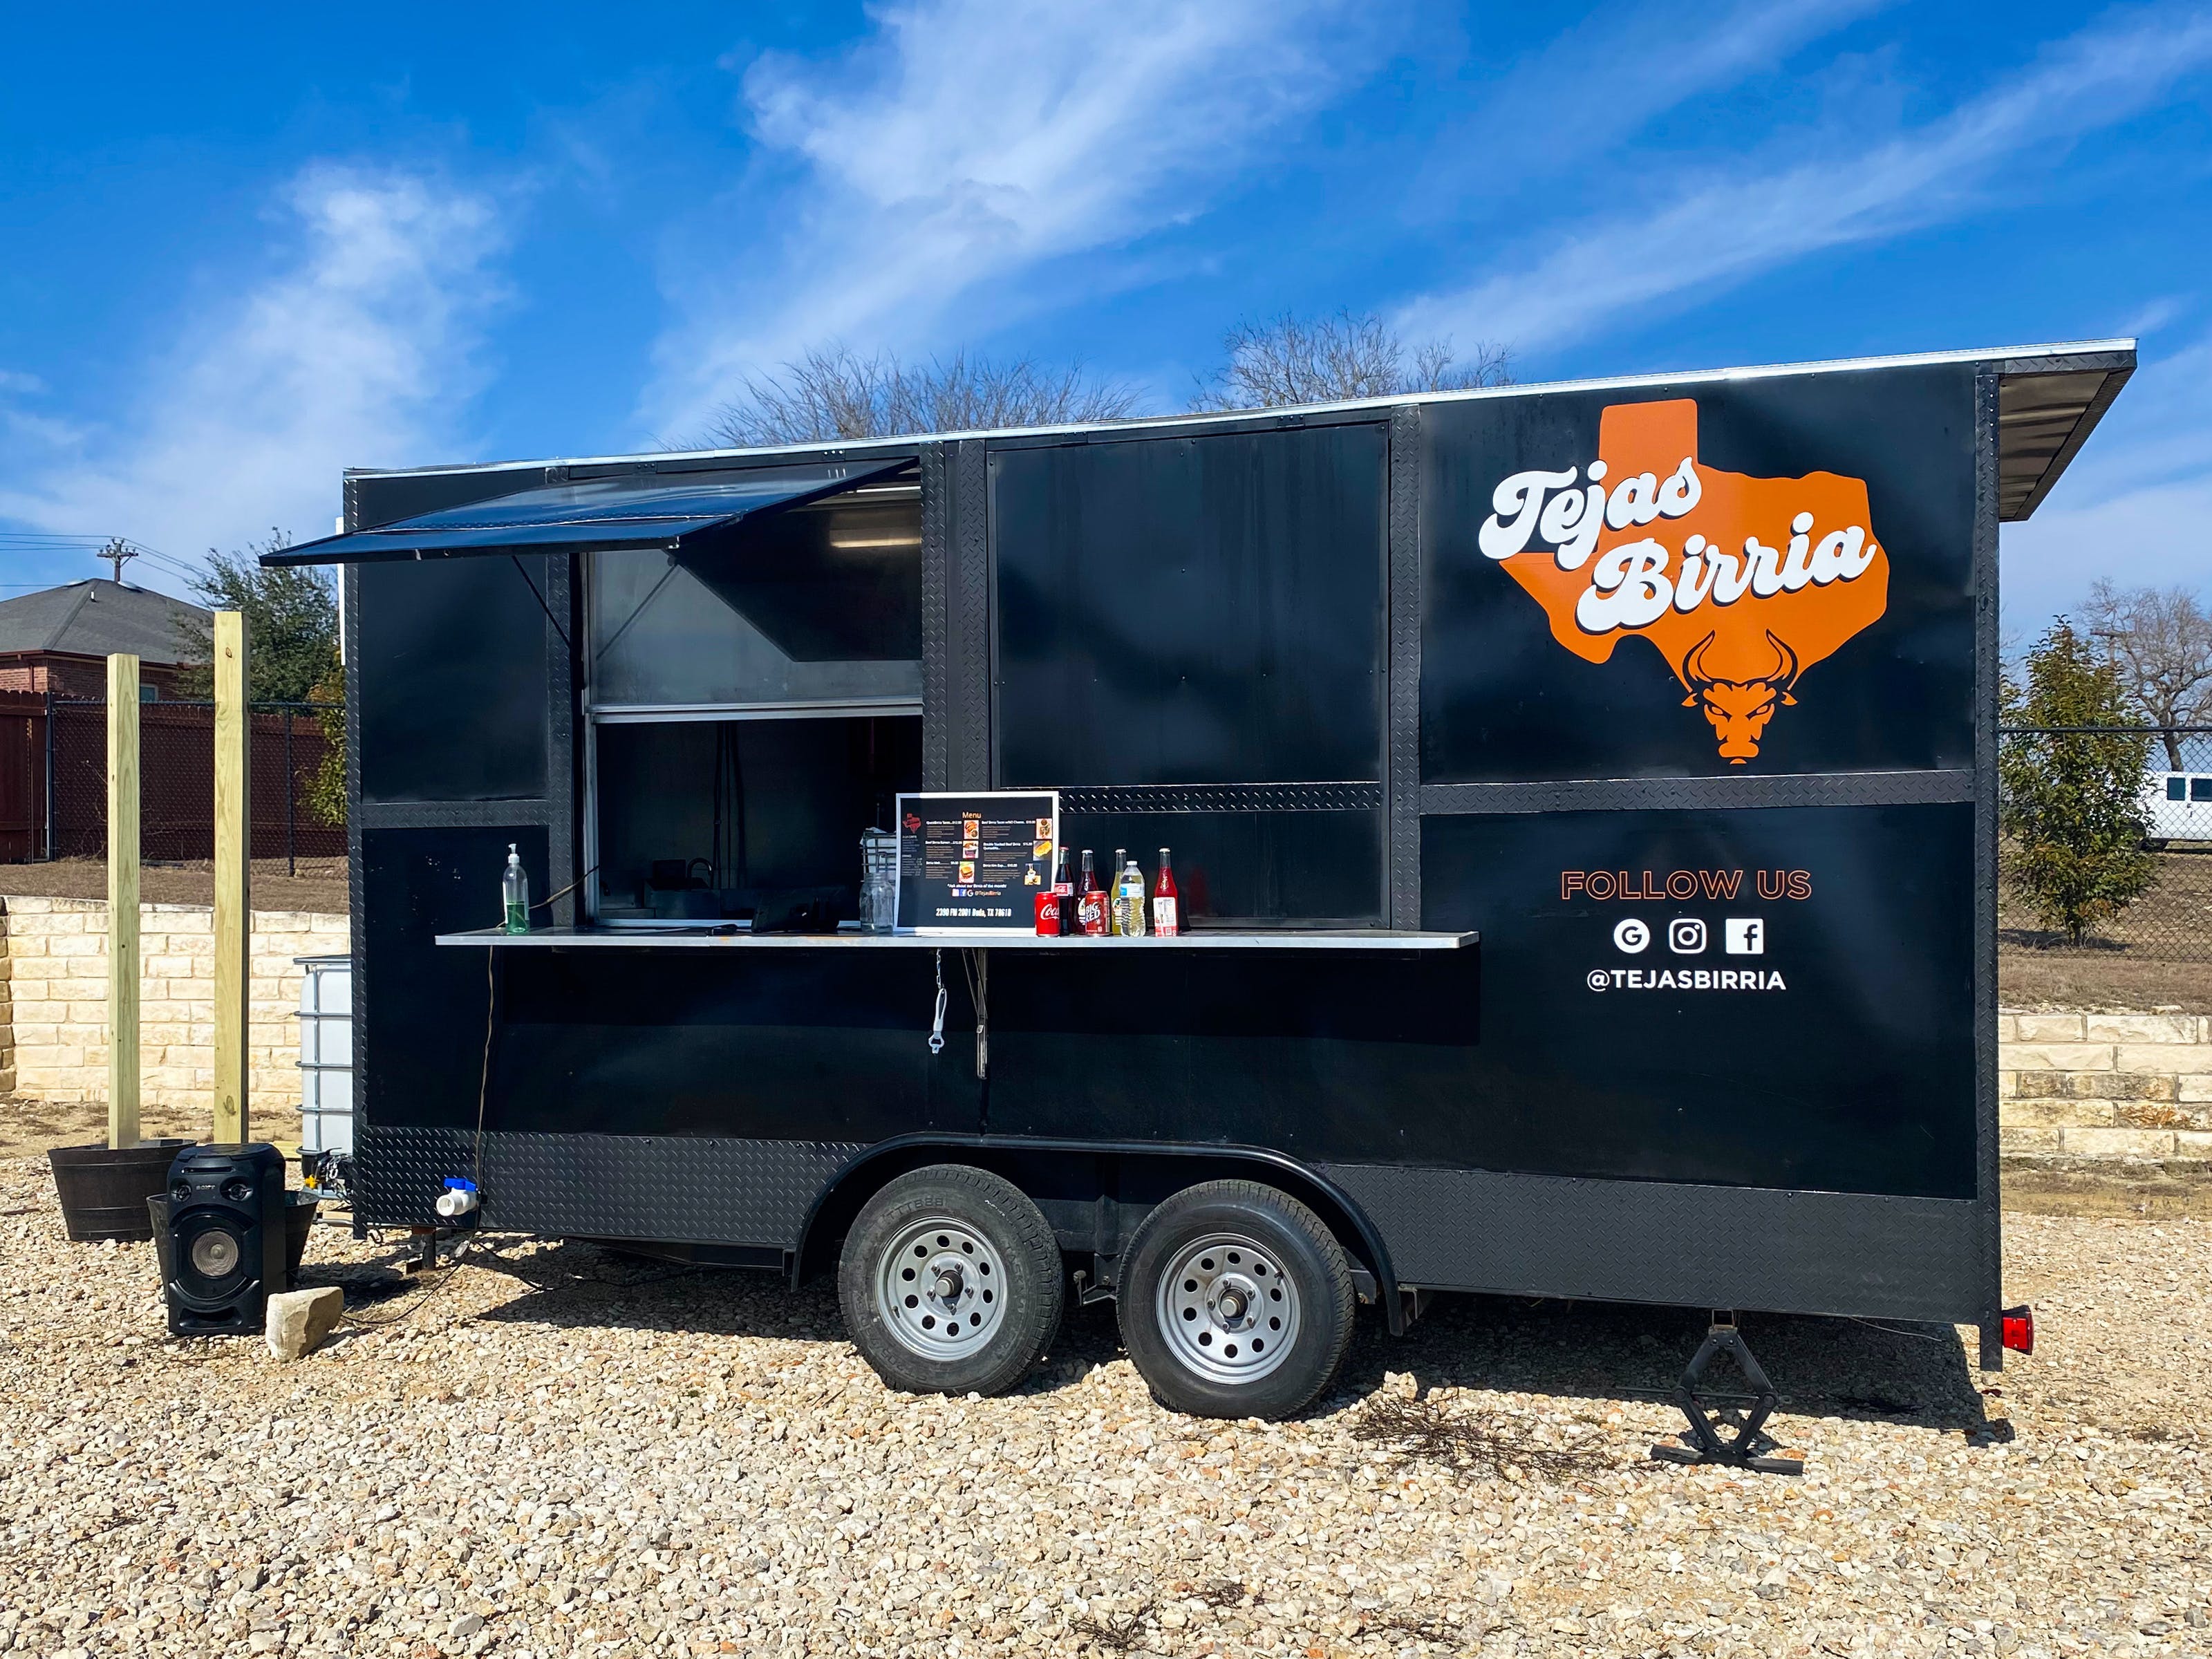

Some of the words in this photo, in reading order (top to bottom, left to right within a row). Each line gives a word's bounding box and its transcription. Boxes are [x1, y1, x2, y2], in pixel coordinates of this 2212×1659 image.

[1478, 456, 1703, 571] Tejas
[1575, 512, 1877, 632] Birria
[1561, 870, 1743, 900] FOLLOW
[1756, 870, 1812, 900] US
[986, 908, 994, 917] TX
[1085, 909, 1101, 924] RED
[1086, 901, 1099, 915] BIG
[1586, 969, 1787, 992] @TEJASBIRRIA
